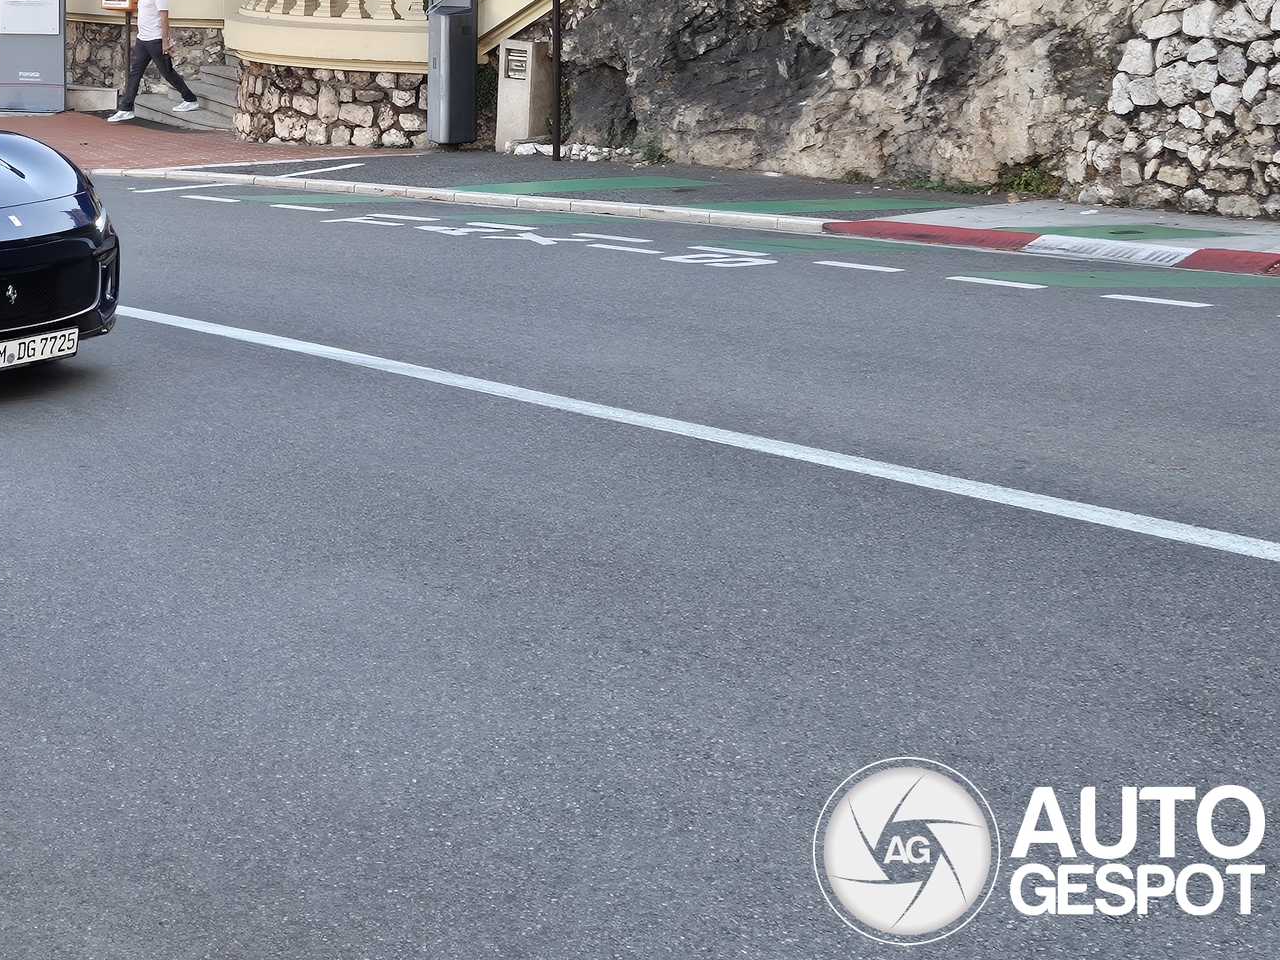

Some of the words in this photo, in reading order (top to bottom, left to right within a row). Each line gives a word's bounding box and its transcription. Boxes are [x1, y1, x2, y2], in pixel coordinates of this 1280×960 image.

[319, 216, 778, 268] TAXIS
[17, 340, 36, 360] DG
[40, 332, 76, 356] 7725
